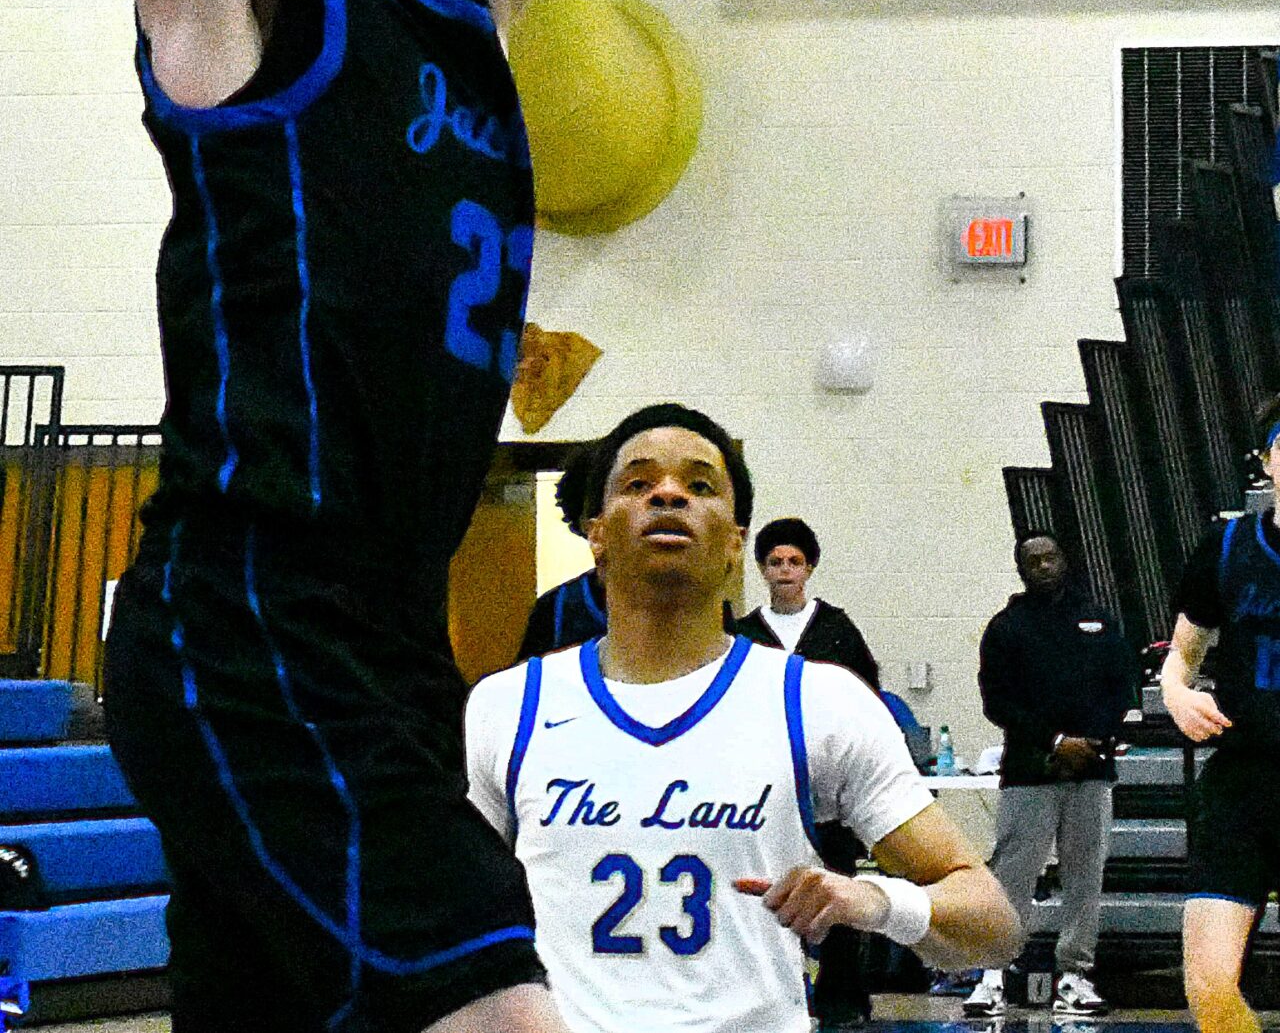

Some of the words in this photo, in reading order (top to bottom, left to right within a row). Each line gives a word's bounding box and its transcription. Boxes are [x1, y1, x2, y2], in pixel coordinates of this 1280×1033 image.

[540, 778, 621, 827] The
[640, 779, 773, 831] Land
[591, 853, 713, 956] 23
